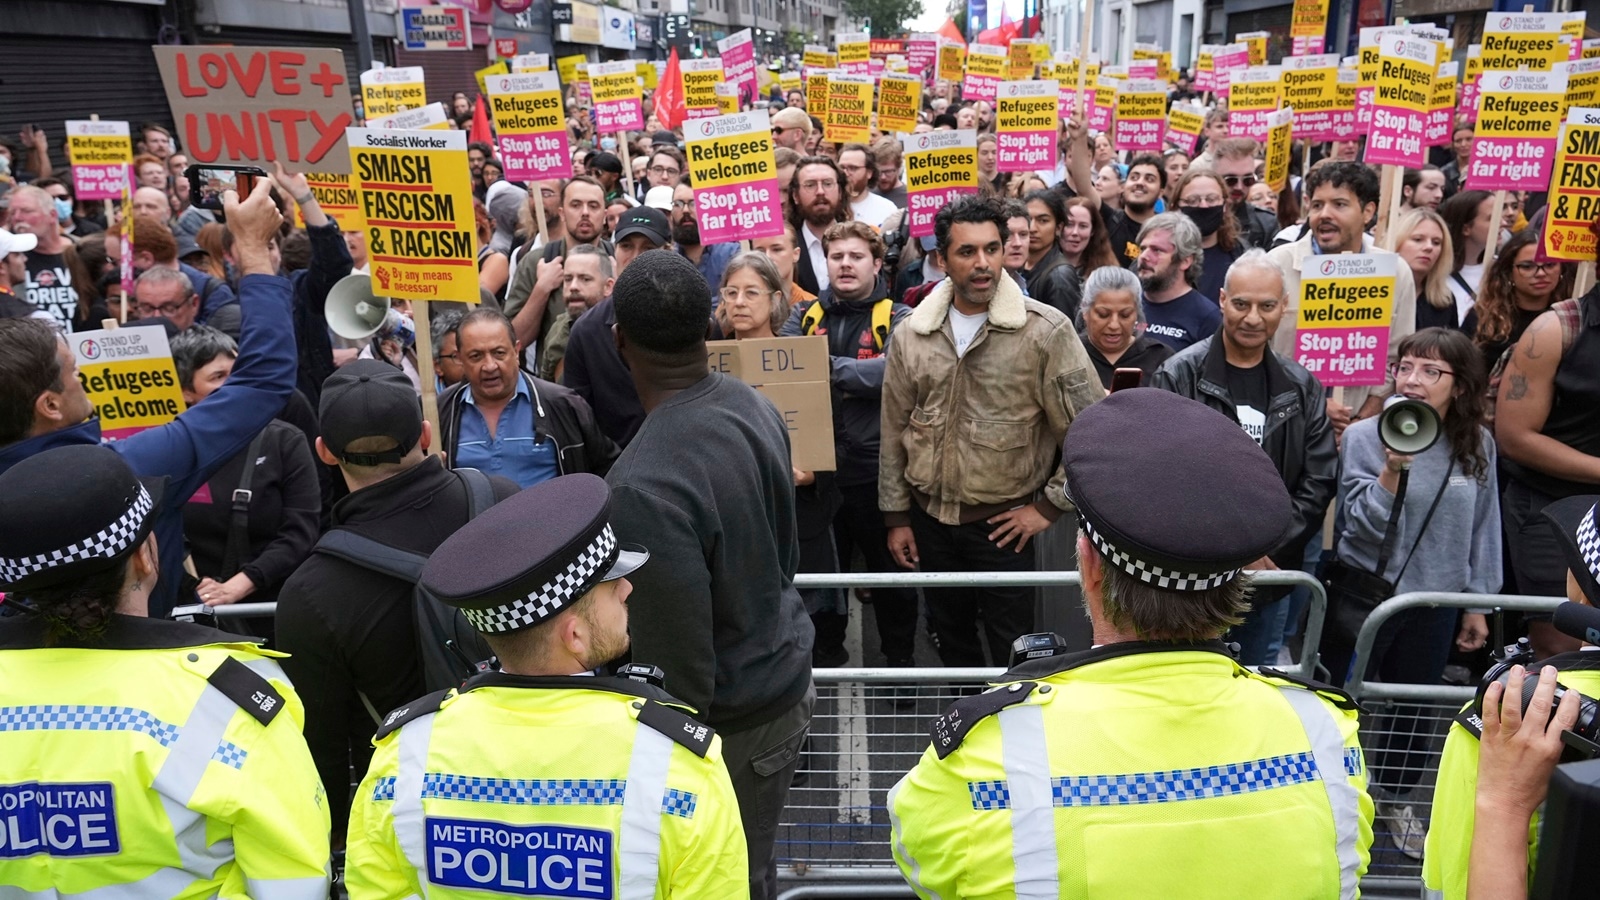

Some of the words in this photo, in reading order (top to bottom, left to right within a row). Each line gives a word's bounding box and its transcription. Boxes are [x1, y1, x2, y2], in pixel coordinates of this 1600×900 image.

[410, 14, 456, 26] MAGAZIN
[408, 30, 463, 42] ROMANESC
[840, 44, 868, 52] Refugees
[1485, 36, 1554, 54] Refugees
[970, 55, 1002, 65] Refugees
[1483, 54, 1546, 68] welcome
[176, 51, 306, 97] LOVE
[968, 65, 999, 73] welcome
[1382, 60, 1431, 86] Refugees
[593, 75, 635, 88] Refugees
[684, 74, 718, 84] Oppose
[882, 80, 908, 91] SMASH
[966, 76, 983, 86] Stop
[1284, 73, 1325, 85] Oppose
[366, 87, 422, 100] Refugees
[595, 87, 634, 98] welcome
[829, 83, 859, 96] SMASH
[964, 85, 976, 93] far
[977, 87, 995, 96] right
[1232, 85, 1276, 95] Refugees
[1284, 87, 1323, 97] Tommy
[1379, 84, 1426, 106] welcome
[494, 97, 558, 113] Refugees
[829, 98, 864, 111] FASCISM
[881, 93, 912, 104] FASCISM
[1119, 96, 1163, 105] Refugees
[1232, 97, 1273, 106] welcome
[1283, 100, 1333, 110] Robinson
[597, 104, 618, 114] Stop
[620, 101, 635, 110] the
[880, 106, 885, 115] &
[887, 106, 915, 118] RACISM
[1000, 101, 1054, 114] Refugees
[1119, 108, 1160, 116] welcome
[1484, 96, 1559, 115] Refugees
[498, 114, 558, 129] welcome
[599, 115, 613, 125] far
[615, 112, 637, 125] right
[715, 118, 737, 126] STAND
[827, 113, 833, 124] &
[837, 114, 868, 126] RACISM
[1000, 115, 1051, 126] welcome
[1231, 113, 1254, 123] Stop
[1300, 113, 1328, 121] fascists
[1374, 109, 1406, 130] Stop
[1408, 114, 1423, 133] the
[1433, 111, 1448, 122] the
[726, 123, 752, 132] RACISM
[1118, 122, 1140, 132] Stop
[1143, 122, 1159, 130] the
[1302, 122, 1313, 130] far
[1314, 121, 1332, 130] right
[1482, 116, 1551, 131] welcome
[185, 110, 352, 164] UNITY
[1231, 126, 1244, 135] far
[1425, 125, 1447, 139] right
[72, 138, 128, 150] Refugees
[366, 135, 408, 148] Socialist
[410, 137, 447, 148] Worker
[1000, 134, 1026, 148] Stop
[1029, 134, 1049, 146] the
[1117, 134, 1131, 143] far
[1133, 133, 1157, 144] right
[1371, 131, 1394, 149] far
[1396, 134, 1420, 156] right
[502, 138, 532, 155] Stop
[535, 136, 560, 150] the
[692, 139, 768, 161] Refugees
[1476, 141, 1513, 161] Stop
[1516, 142, 1544, 158] the
[74, 150, 126, 160] welcome
[909, 153, 973, 169] Refugees
[1000, 149, 1016, 162] far
[1019, 149, 1048, 163] right
[357, 152, 432, 184] SMASH
[505, 154, 525, 169] far
[527, 153, 562, 172] right
[76, 167, 104, 180] Stop
[695, 160, 767, 181] welcome
[1472, 160, 1497, 177] far
[1500, 161, 1541, 181] right
[910, 170, 970, 186] welcome
[78, 180, 98, 191] far
[698, 192, 737, 210] Stop
[740, 186, 769, 204] the
[911, 194, 944, 209] Stop
[362, 191, 455, 221] FASCISM
[1553, 195, 1568, 219] &
[702, 213, 726, 230] far
[731, 206, 771, 228] right
[912, 212, 933, 225] far
[1567, 230, 1577, 241] By
[370, 227, 386, 254] &
[390, 230, 472, 258] RACISM
[392, 267, 402, 280] By
[405, 271, 420, 282] any
[423, 270, 452, 281] means
[1349, 267, 1376, 275] RACISM
[394, 282, 438, 294] necessary
[1305, 282, 1389, 304] Refugees
[1304, 304, 1382, 321] welcome
[1146, 324, 1183, 338] JONES
[101, 337, 128, 347] STAND
[130, 335, 141, 345] UP
[1300, 333, 1343, 354] Stop
[1347, 332, 1378, 350] the
[105, 348, 115, 357] TO
[117, 346, 148, 356] RACISM
[762, 349, 804, 371] EDL
[1298, 355, 1325, 371] far
[1329, 353, 1374, 375] right
[79, 368, 174, 394] Refugees
[251, 691, 266, 704] EA
[948, 709, 962, 731] EA
[0, 790, 105, 810] OPOLITAN
[433, 824, 604, 854] METROPOLITAN
[434, 846, 604, 893] POLICE
